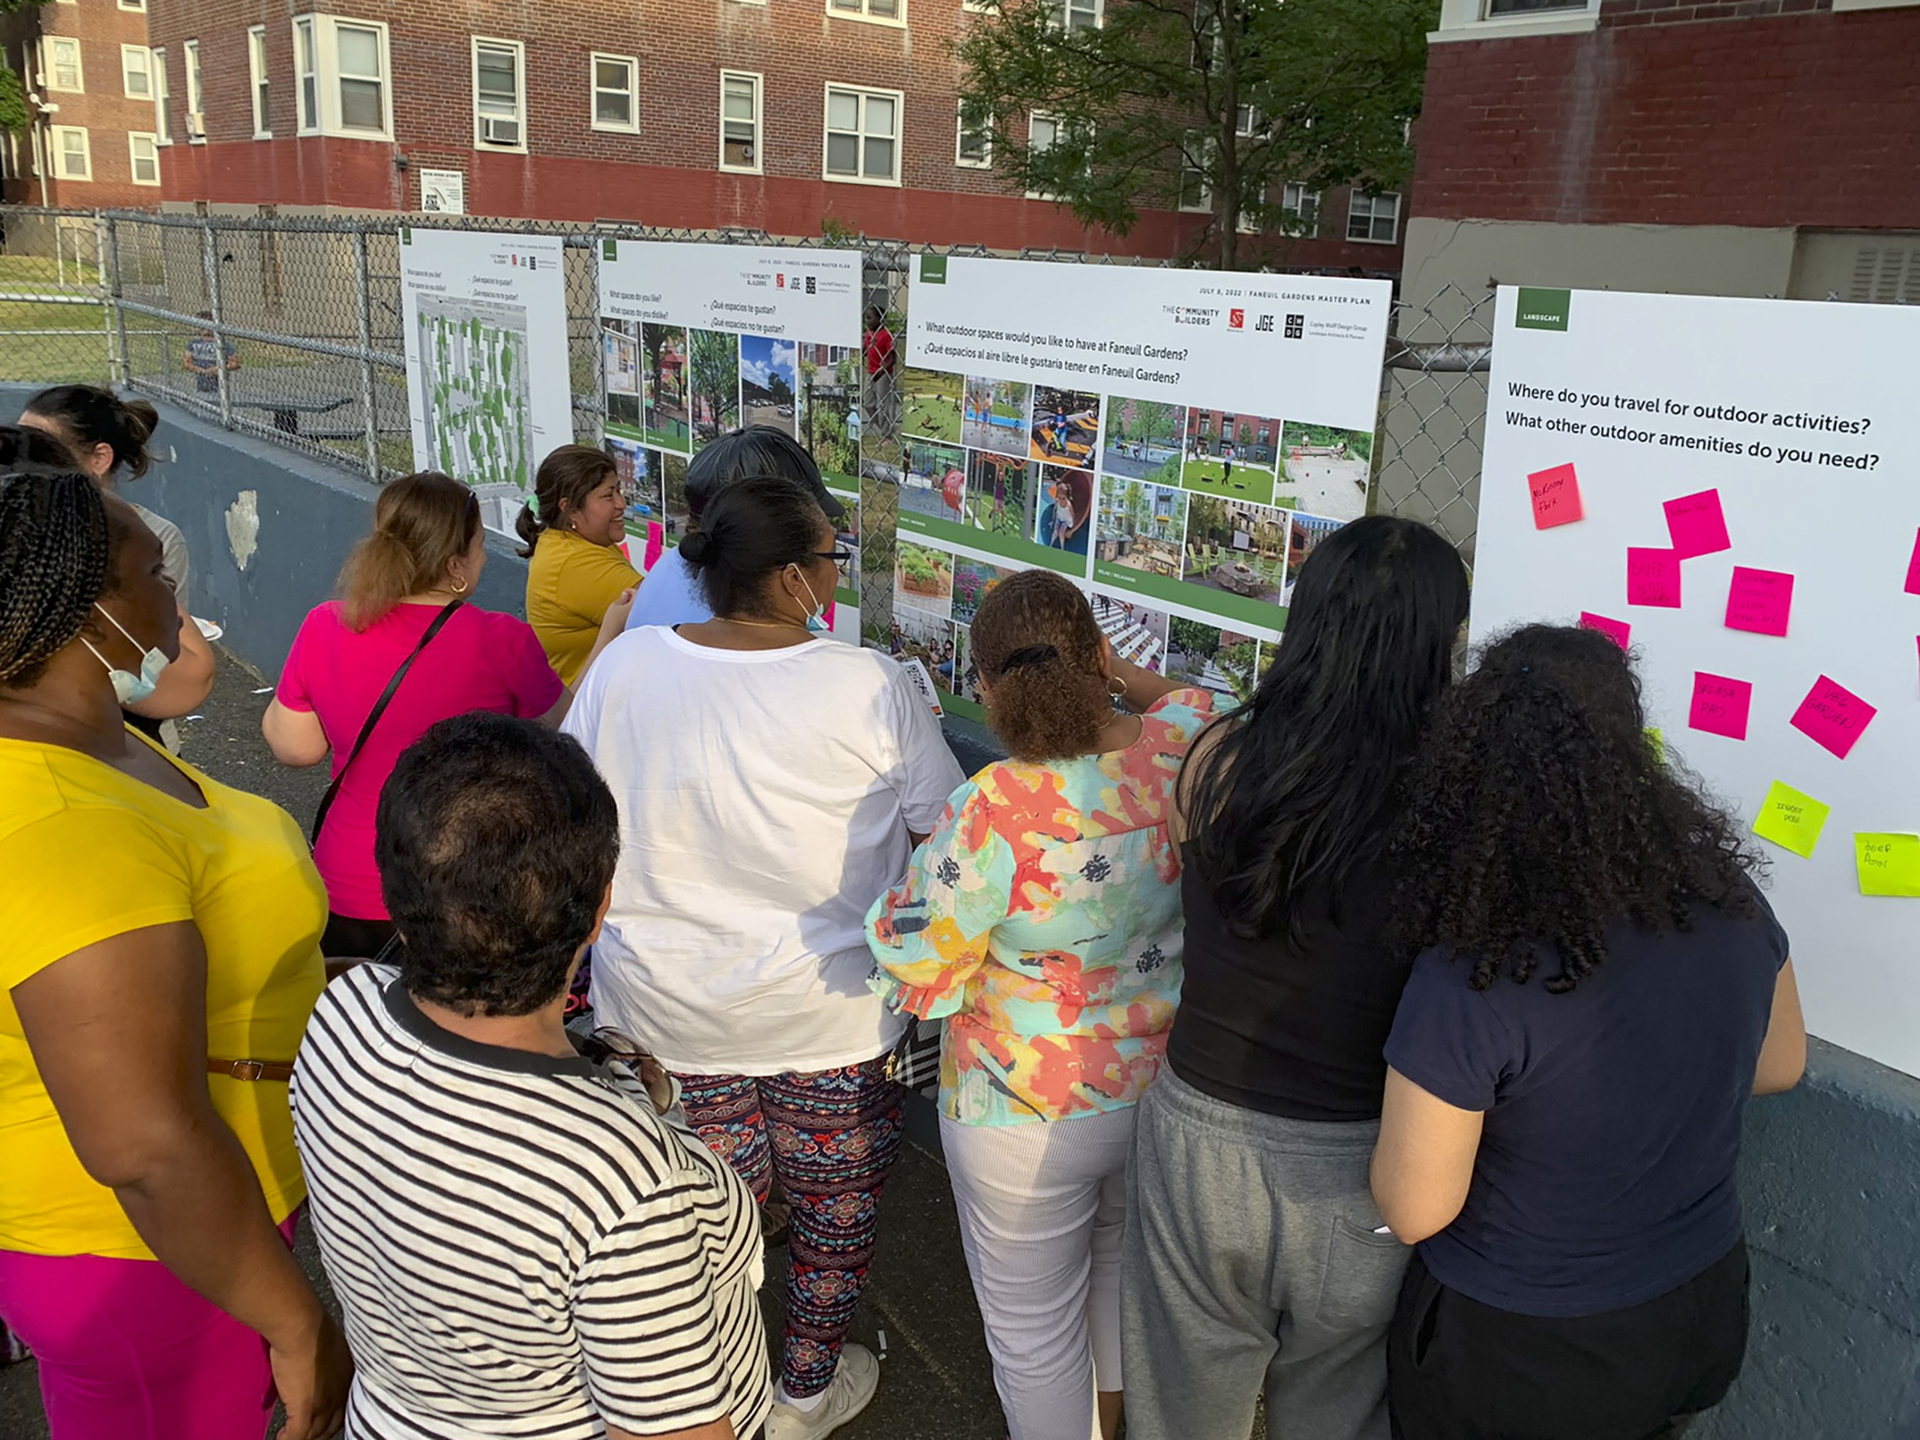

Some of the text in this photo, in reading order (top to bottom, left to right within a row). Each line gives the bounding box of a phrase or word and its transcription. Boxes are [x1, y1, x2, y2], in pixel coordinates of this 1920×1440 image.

[610, 290, 620, 298] What
[621, 292, 635, 301] spaces
[642, 295, 650, 303] you
[651, 294, 662, 303] like?
[1249, 290, 1278, 299] FANEUIL
[1281, 292, 1316, 301] GARDENS
[1318, 295, 1348, 304] MASTER
[610, 306, 621, 314] What
[642, 311, 651, 319] you
[651, 310, 669, 320] dislike?
[710, 300, 776, 315] ¿Qué espacios te gustan?
[711, 317, 724, 328] ¿Qué
[725, 320, 748, 330] espacios
[756, 323, 762, 332] te
[763, 324, 785, 334] gustan?
[1255, 314, 1274, 332] JGE
[1523, 314, 1560, 322] LANDSCAPE
[925, 321, 1188, 361] What outdoor spaces would you like to have at Faneuil Gardens?
[924, 342, 1180, 384] ¿Qué espacios al aire libre le gustaría tener en Faneuil Gardens?
[1508, 382, 1871, 435] Where do you travel for outdoor activities?
[1506, 411, 1879, 471] What other outdoor amenities do you need?
[1701, 702, 1726, 719] PAD
[1805, 698, 1858, 729] GARDEN
